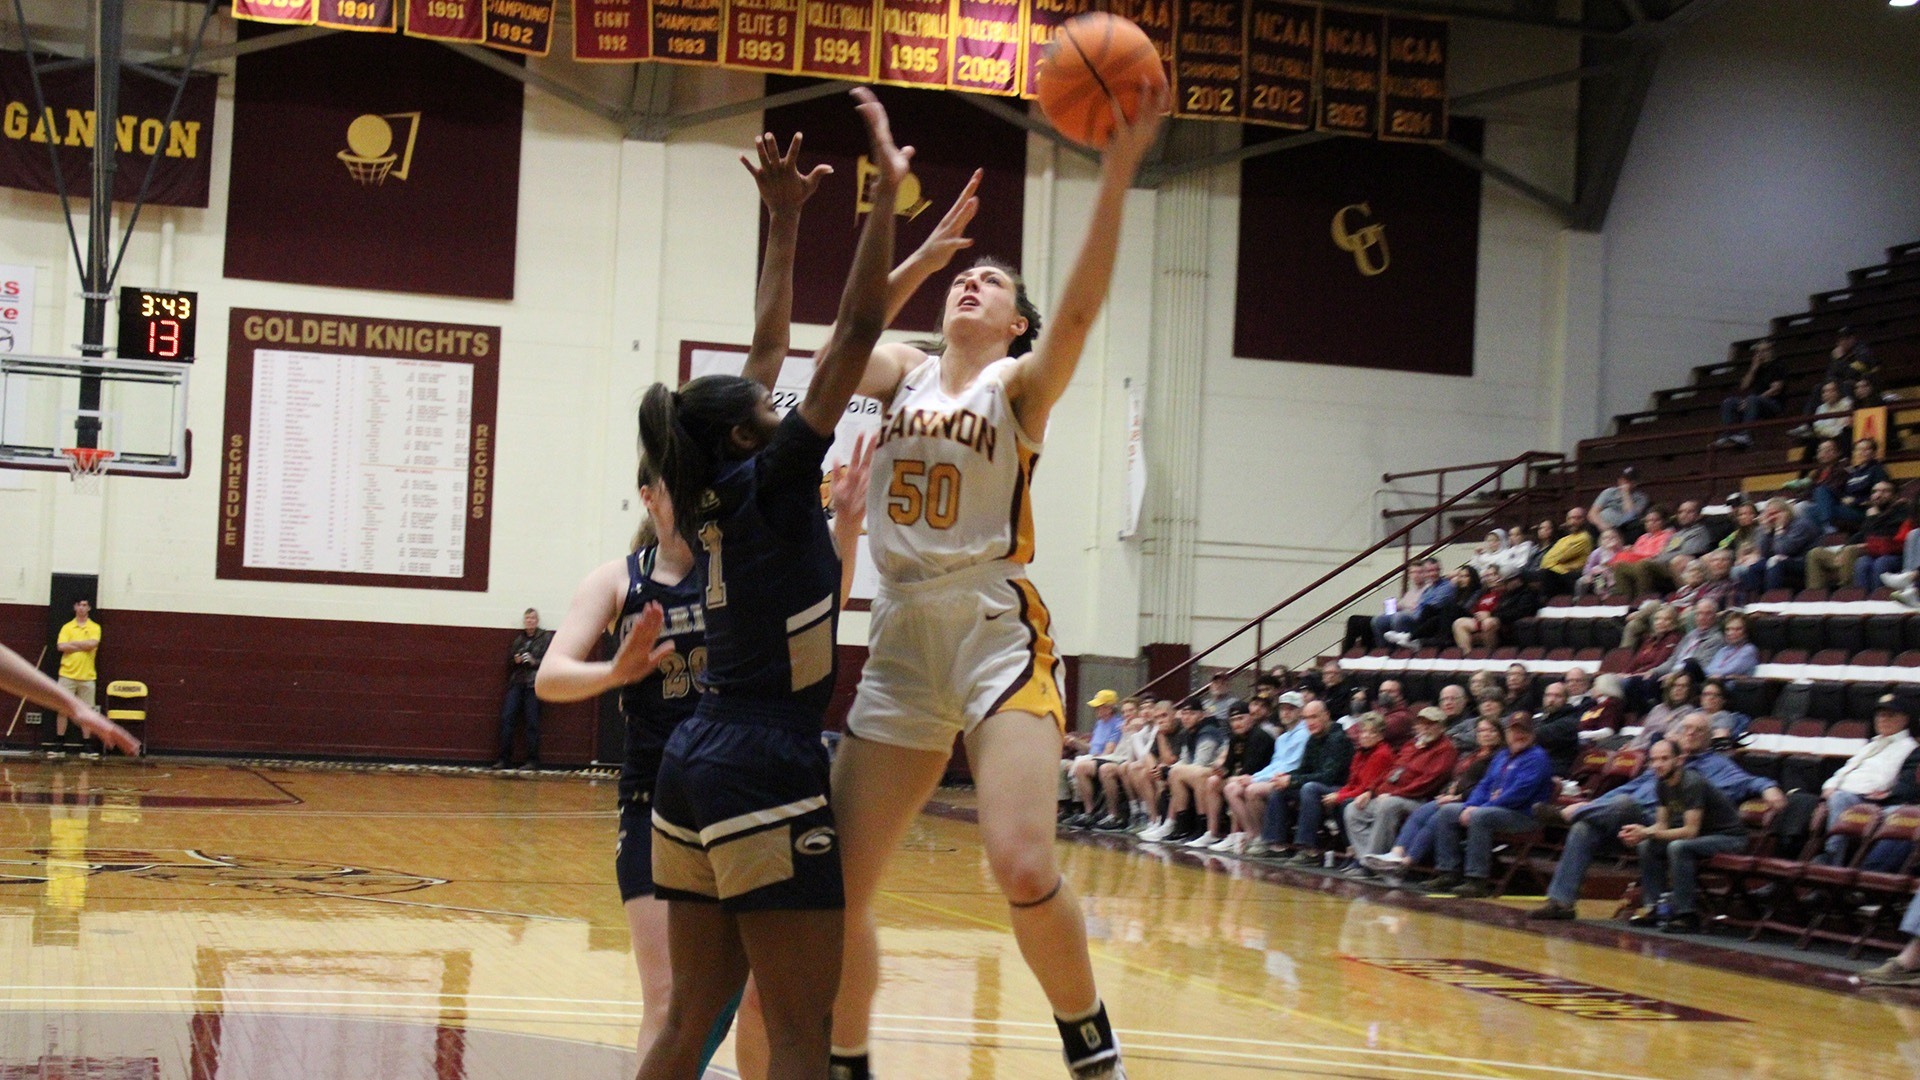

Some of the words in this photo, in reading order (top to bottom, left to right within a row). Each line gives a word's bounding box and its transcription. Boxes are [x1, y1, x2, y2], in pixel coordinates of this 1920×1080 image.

[428, 1, 465, 19] 1991
[737, 12, 774, 35] ELITE
[883, 7, 949, 39] VOLLEYBALL
[492, 21, 534, 44] 1992
[1254, 10, 1311, 46] NCAA
[1325, 27, 1378, 57] NCAA
[737, 38, 786, 62] 1993
[813, 36, 861, 66] 1994
[890, 44, 939, 73] 1995
[1390, 37, 1442, 63] NCAA
[957, 55, 1011, 84] 2009
[1186, 85, 1234, 112] 2012
[1252, 84, 1304, 113] 2012
[3, 101, 201, 159] GANNON
[142, 294, 191, 319] 3:43
[149, 320, 179, 356] 13
[243, 315, 357, 348] GOLDEN
[365, 324, 490, 357] KNIGHTS
[472, 423, 489, 519] RECORDS
[225, 434, 243, 546] SCHEDULE
[888, 459, 962, 530] 50
[698, 519, 727, 610] 1
